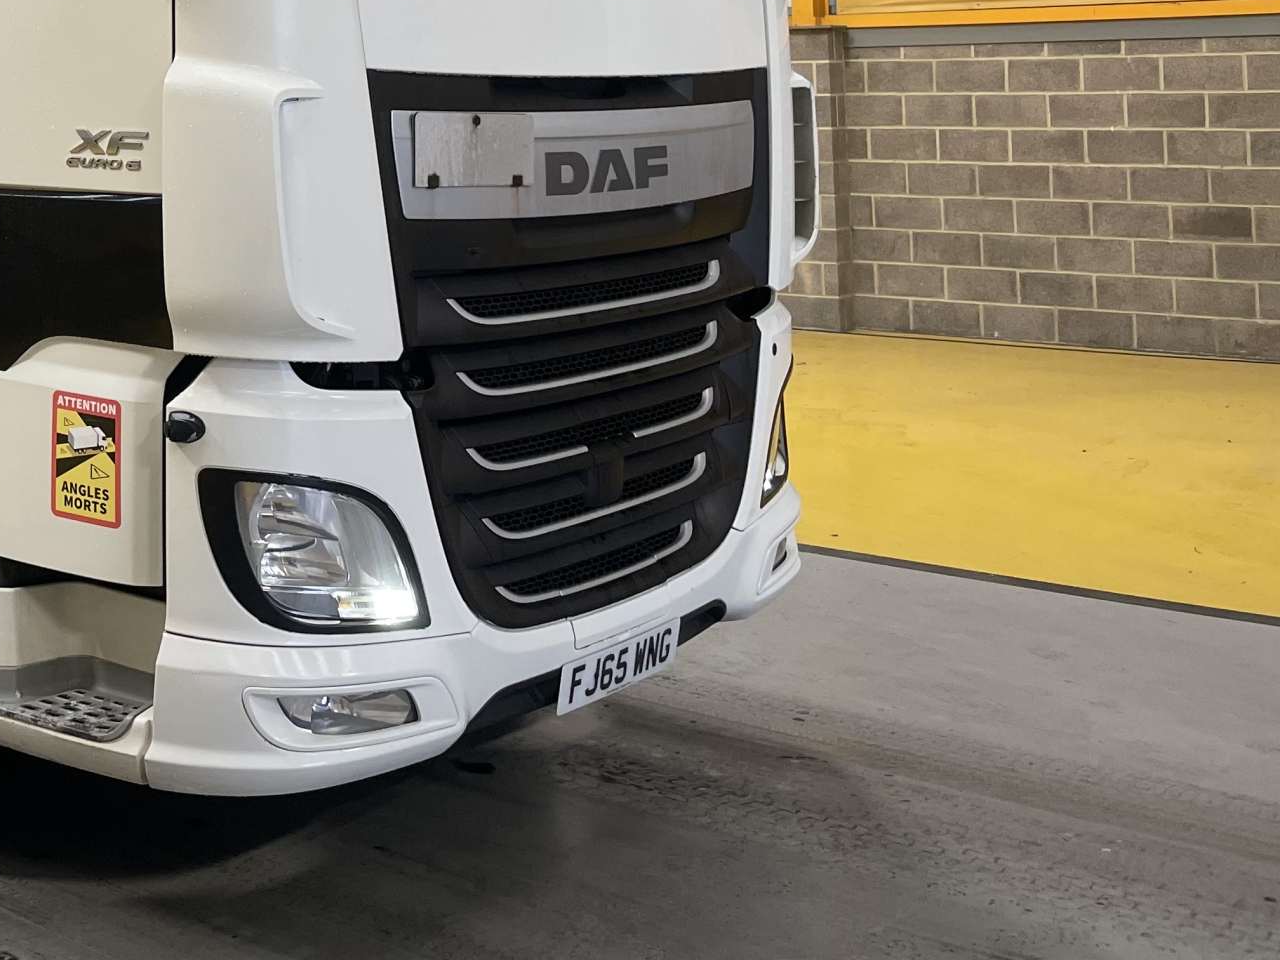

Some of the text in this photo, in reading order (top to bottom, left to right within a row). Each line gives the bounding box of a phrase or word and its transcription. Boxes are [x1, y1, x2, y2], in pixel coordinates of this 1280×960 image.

[68, 128, 150, 156] XF
[65, 156, 123, 171] EURO
[544, 145, 669, 196] DAF
[56, 394, 117, 416] ATTENTION
[61, 480, 110, 501] ANGLES
[63, 494, 107, 515] MORTS
[568, 627, 672, 705] FJ65 WNG
